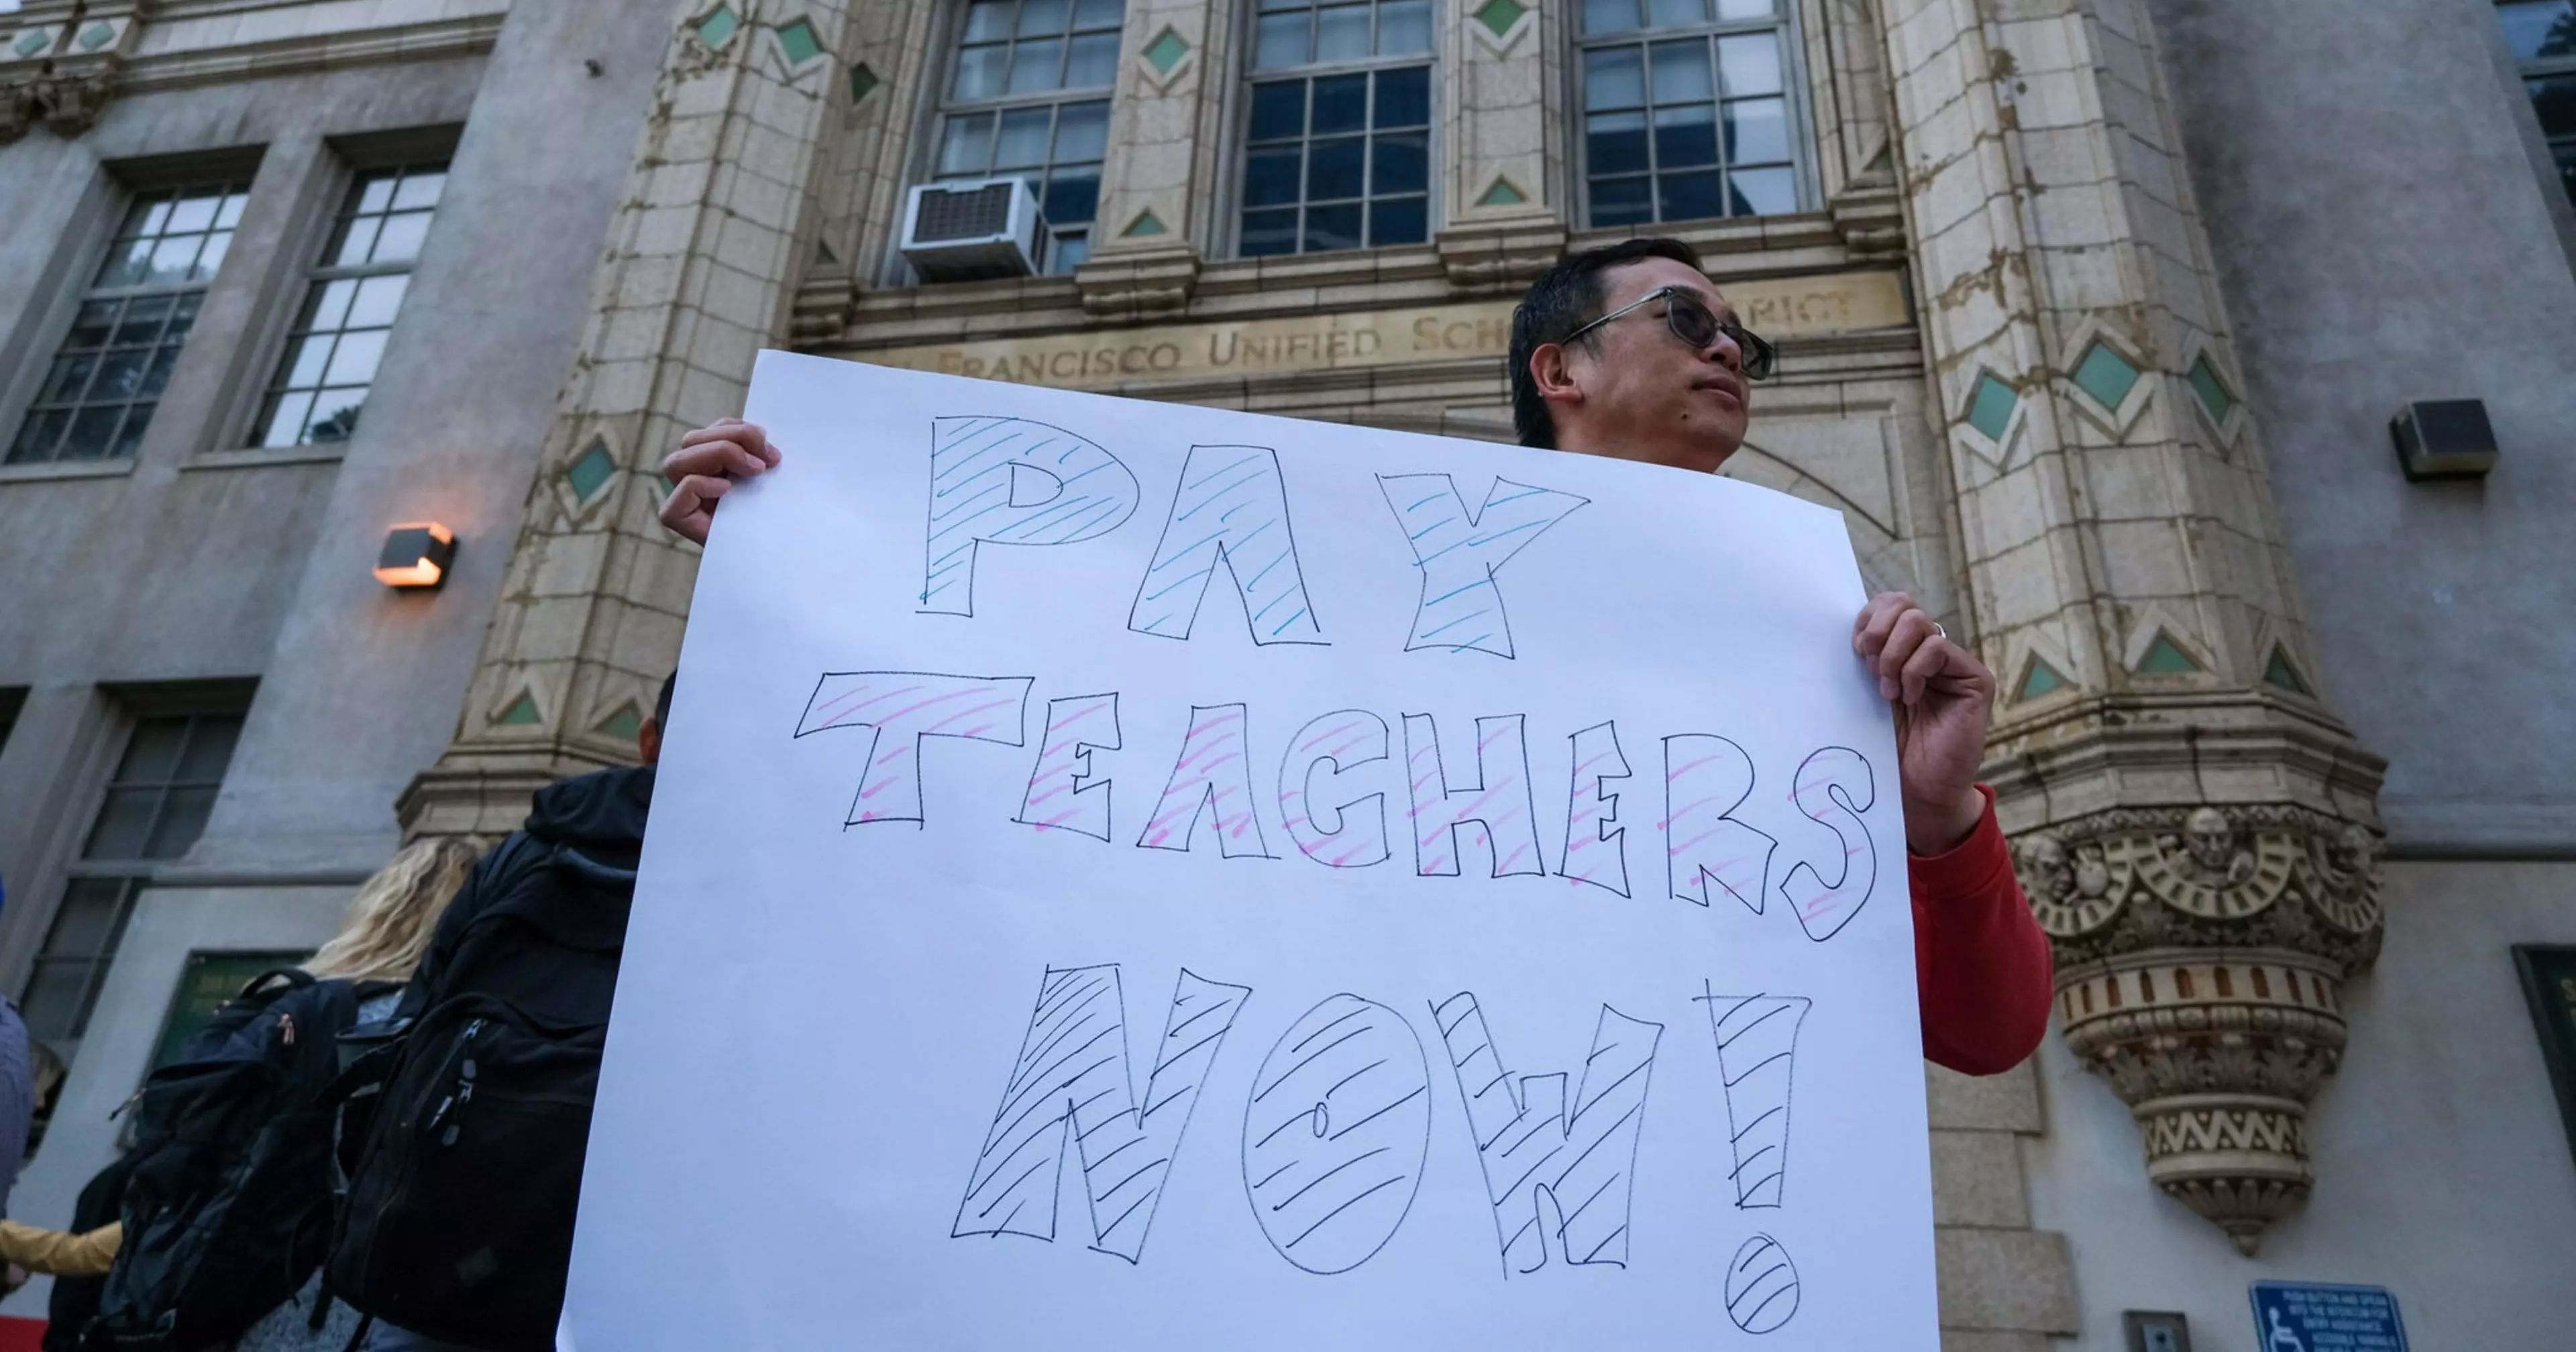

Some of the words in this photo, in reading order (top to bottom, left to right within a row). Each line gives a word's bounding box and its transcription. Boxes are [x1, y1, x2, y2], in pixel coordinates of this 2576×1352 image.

[938, 342, 1181, 384] FRANCISCO
[1208, 329, 1382, 368] UNIFIED
[1412, 316, 1512, 351] SCH
[1747, 290, 1853, 327] RICT
[915, 415, 1591, 661] PAY
[794, 671, 1877, 942] TEACHERS
[951, 962, 1813, 1335] NOW!
